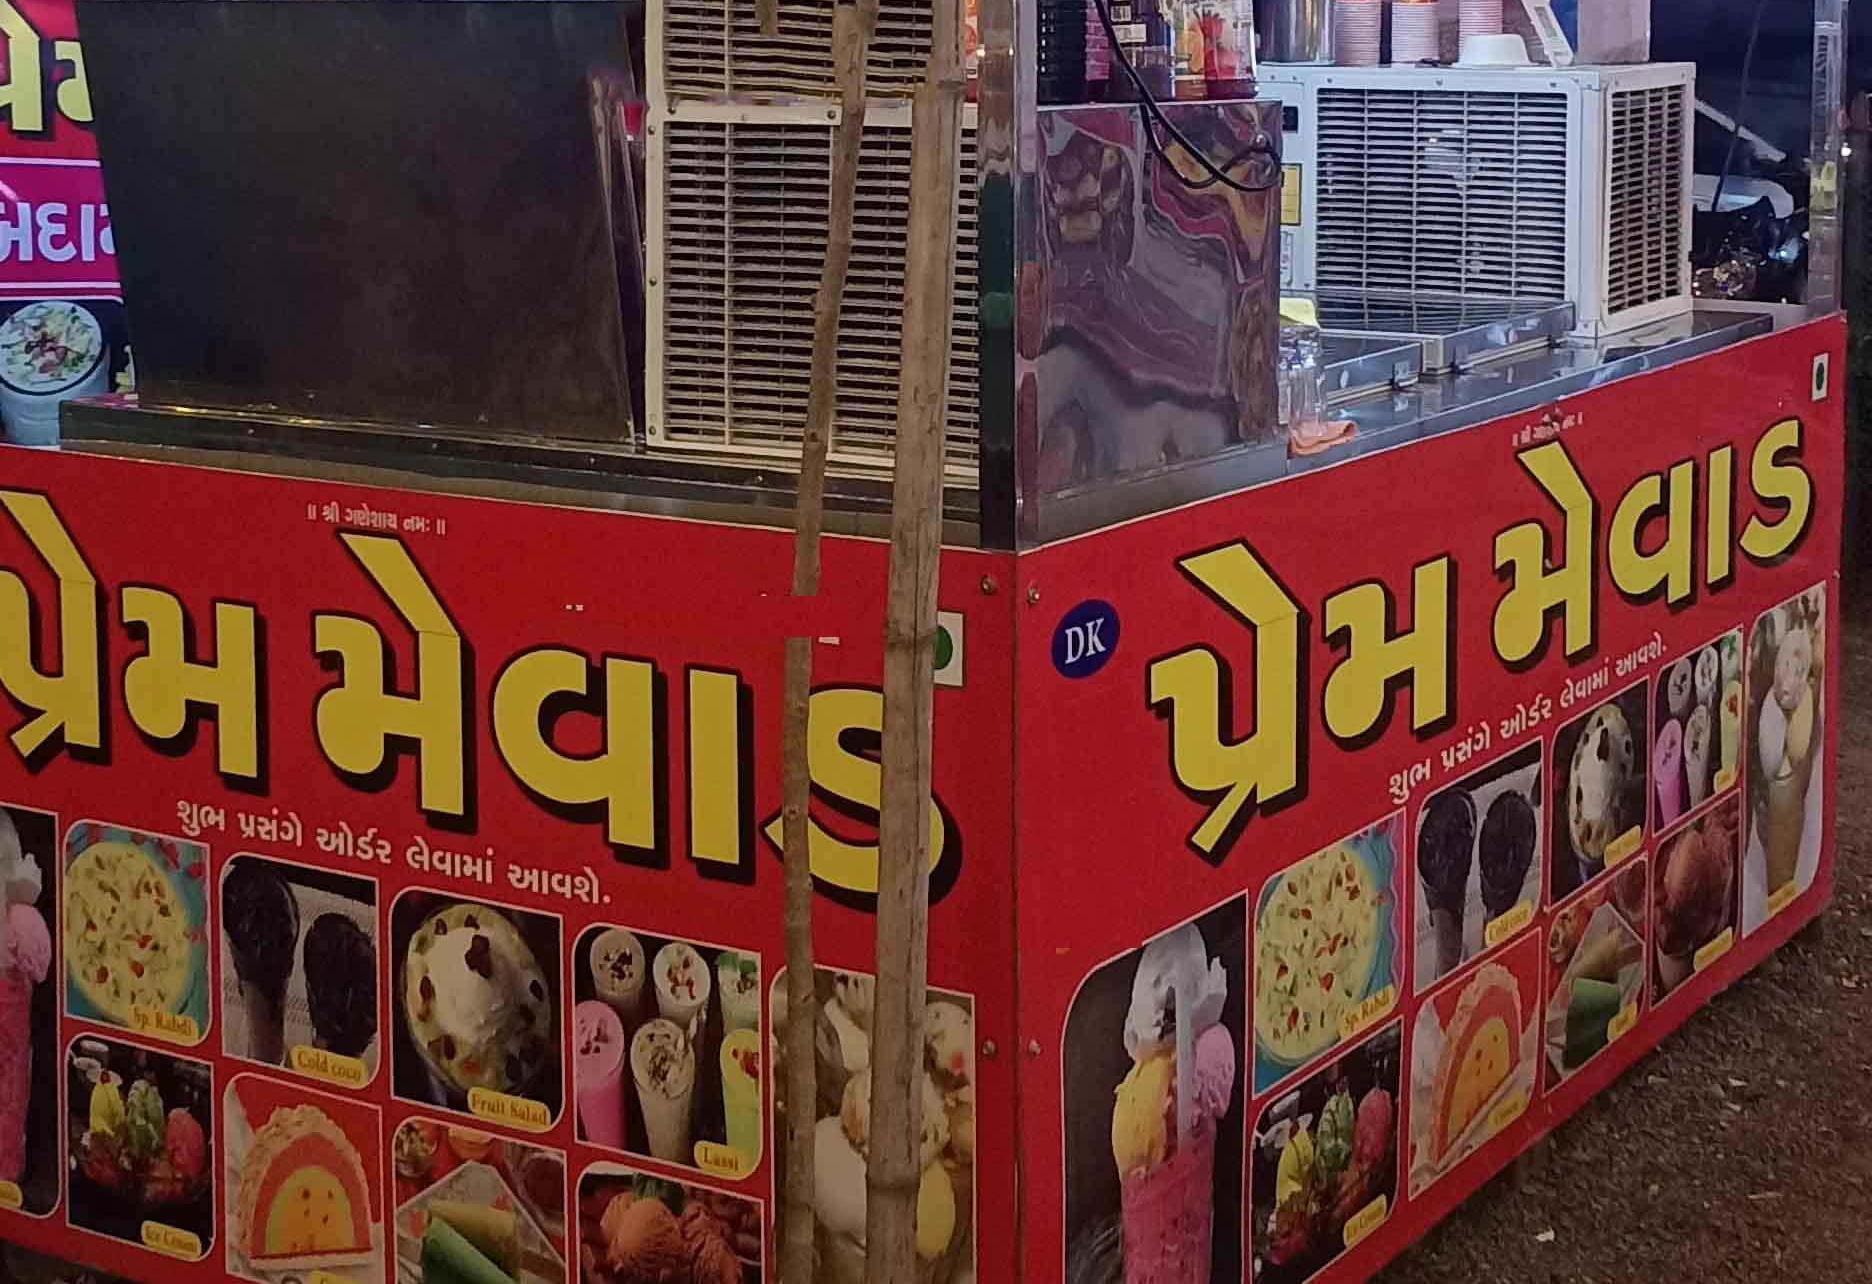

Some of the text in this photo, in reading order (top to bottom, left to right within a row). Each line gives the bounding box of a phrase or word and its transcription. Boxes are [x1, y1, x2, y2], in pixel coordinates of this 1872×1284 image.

[1064, 617, 1107, 665] DK
[1149, 419, 1813, 854] પ્રેમ મેવાડ
[0, 490, 948, 894] પ્રેમ મેવાડ
[1388, 631, 1668, 805] શુભ પ્રસંગે ઓર્ડર લેવામાં આવશે.
[176, 799, 612, 904] શુભ પ્રસંગે ઓર્ડર લેવામાં આવશે.
[298, 1051, 328, 1072] Cold
[471, 1093, 548, 1126] Fruit Salad
